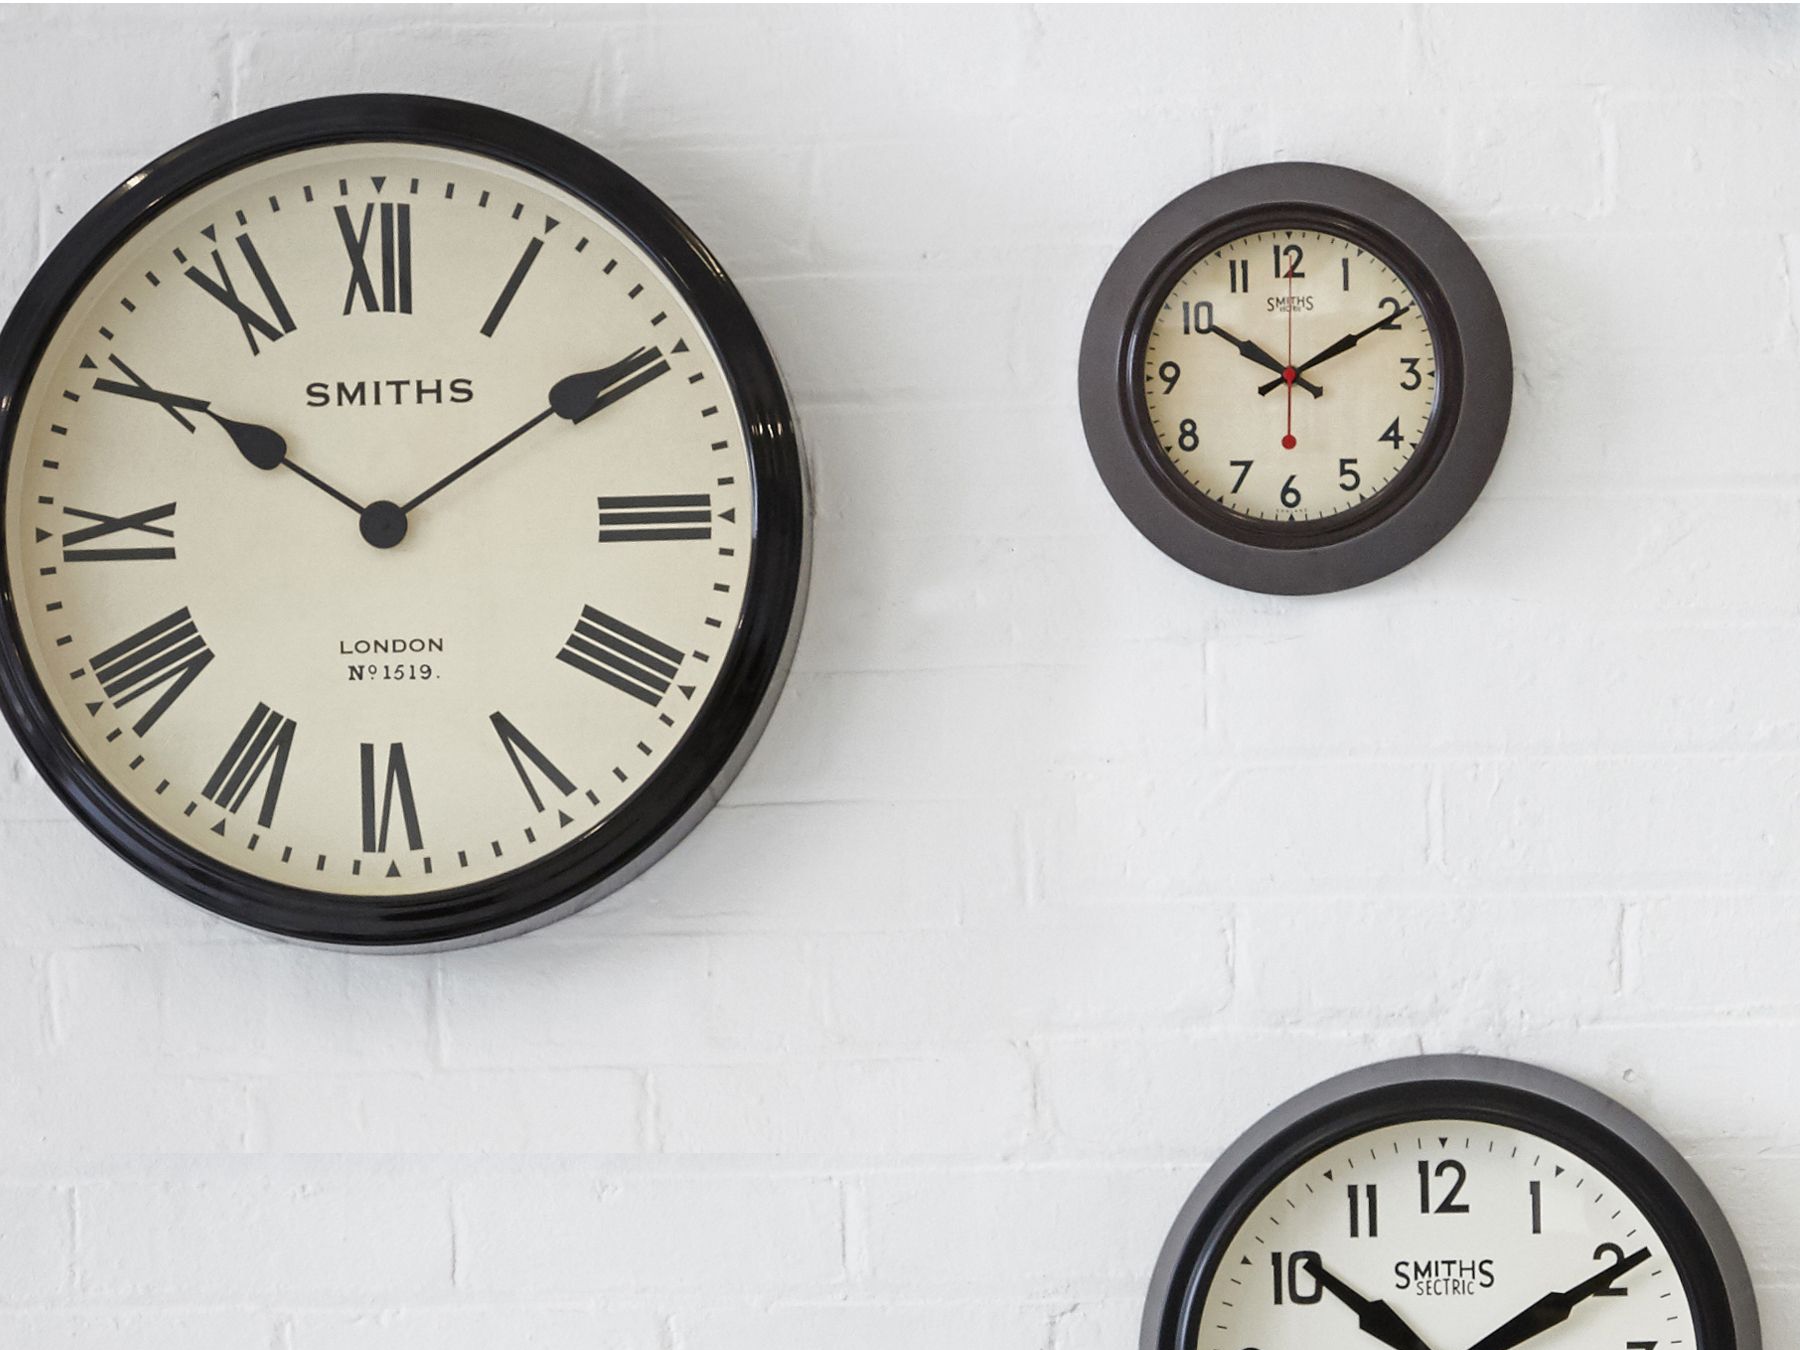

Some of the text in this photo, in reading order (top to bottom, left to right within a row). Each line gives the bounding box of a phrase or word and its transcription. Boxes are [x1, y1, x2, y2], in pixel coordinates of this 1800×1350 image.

[334, 203, 413, 316] XII
[1228, 259, 1249, 293] 11
[1273, 243, 1306, 280] 12
[1342, 258, 1350, 292] 1
[184, 232, 298, 357] XI
[480, 237, 545, 338] I
[1183, 301, 1213, 335] 10
[1379, 296, 1402, 330] 2
[1159, 361, 1181, 396] 9
[1400, 358, 1422, 391] 3
[306, 378, 475, 408] SMITHS
[1178, 418, 1200, 453] 8
[1378, 416, 1405, 450] 4
[1230, 460, 1254, 495] 7
[1280, 474, 1302, 509] 6
[1340, 458, 1361, 492] 5
[62, 502, 177, 562] IX
[598, 493, 712, 543] III
[340, 638, 443, 654] LONDON
[490, 711, 578, 813] V
[1417, 1160, 1470, 1214] 12
[1348, 1184, 1378, 1239] 11
[1530, 1180, 1542, 1236] 1
[1271, 1250, 1323, 1306] 10
[1394, 1259, 1495, 1290] SMITHS
[1416, 1278, 1475, 1296] SECTRIC
[1593, 1242, 1628, 1297] 2
